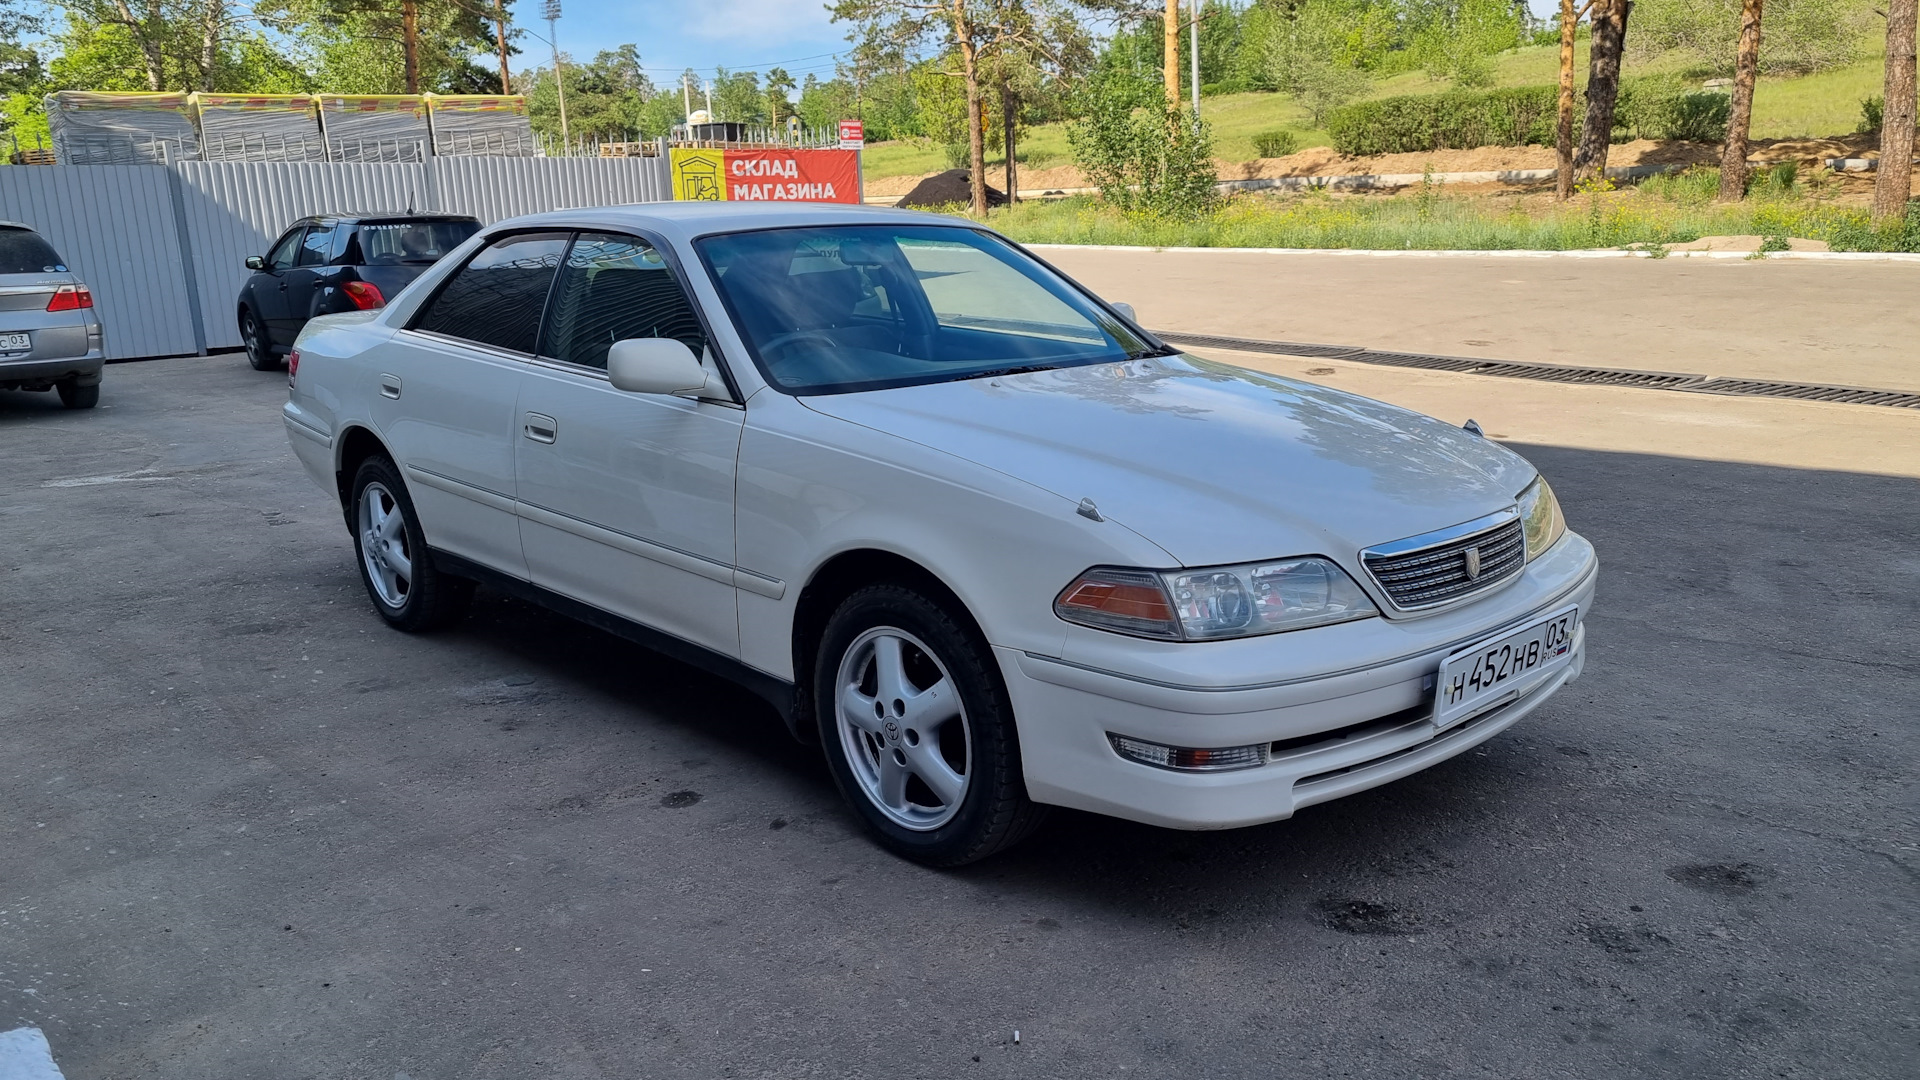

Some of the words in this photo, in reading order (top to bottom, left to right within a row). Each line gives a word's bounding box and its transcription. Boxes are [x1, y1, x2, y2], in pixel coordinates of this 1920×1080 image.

[732, 160, 798, 178] СКЛАД
[734, 183, 836, 200] МАГАЗИНА
[10, 335, 25, 345] 03
[1546, 617, 1568, 649] 03
[1543, 649, 1558, 662] RUS
